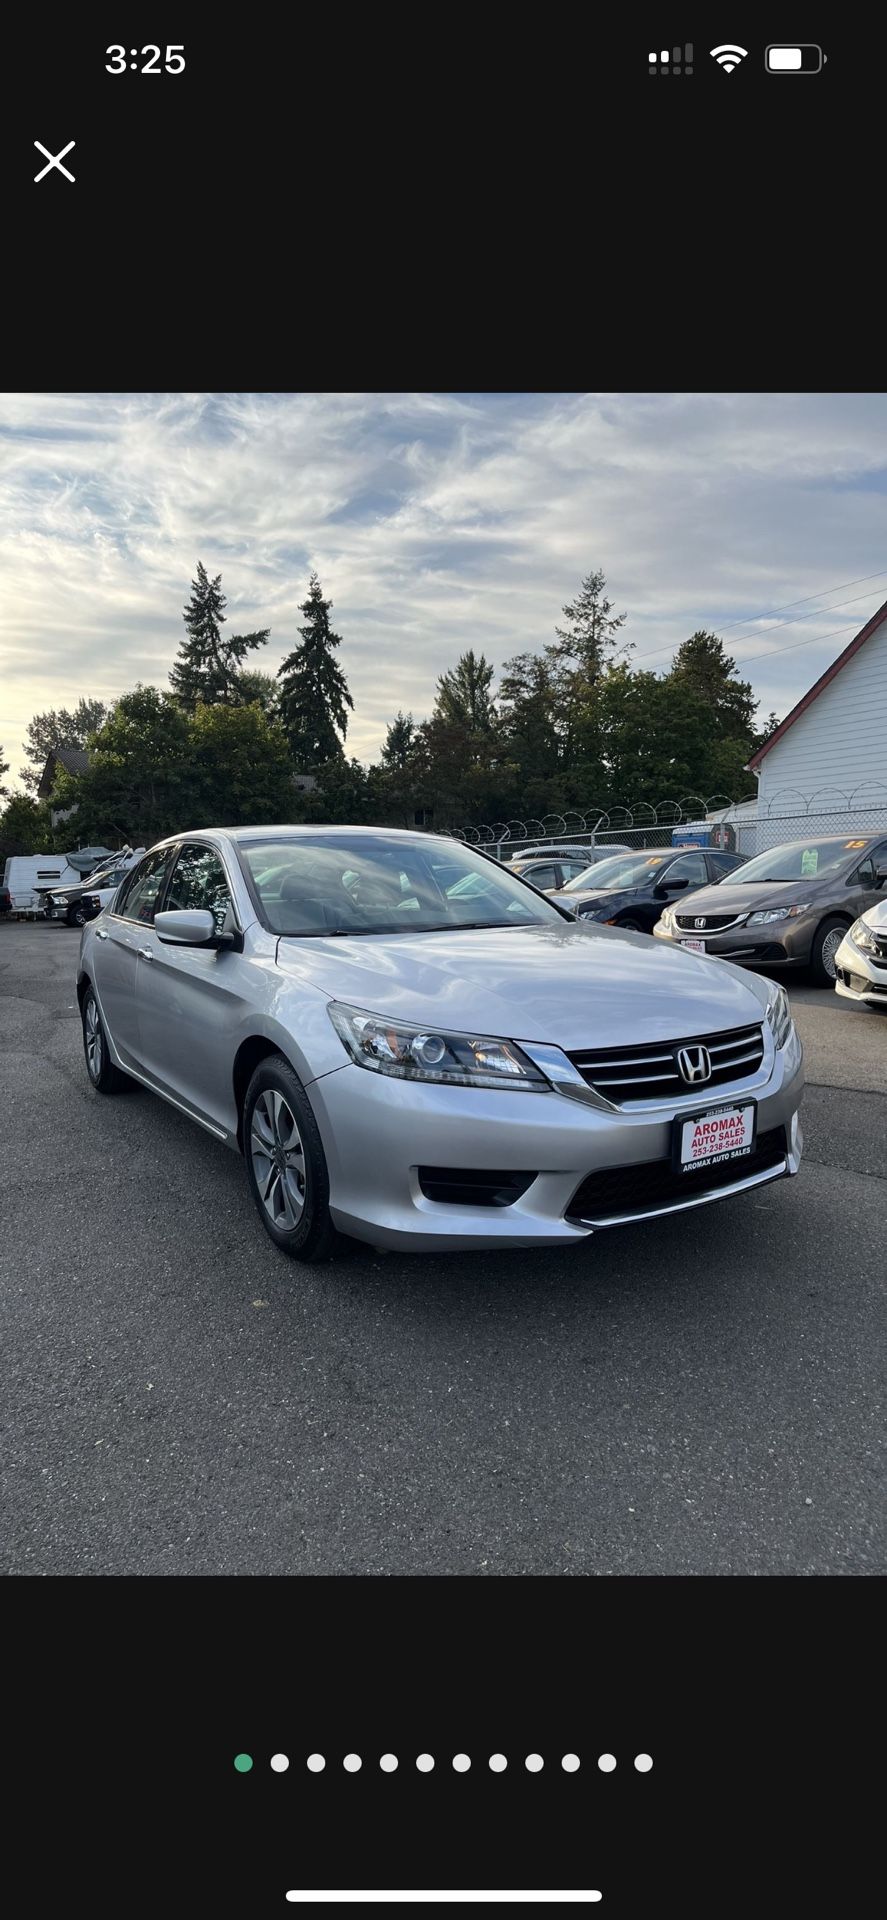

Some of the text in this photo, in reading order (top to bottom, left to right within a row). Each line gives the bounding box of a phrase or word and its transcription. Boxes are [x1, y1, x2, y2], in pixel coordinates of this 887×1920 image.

[694, 1115, 744, 1137] AROMAX
[691, 1127, 745, 1149] AUTO SALES
[692, 1137, 744, 1157] 253-238-5440
[683, 1147, 751, 1172] AROMAX AUTO SALES
